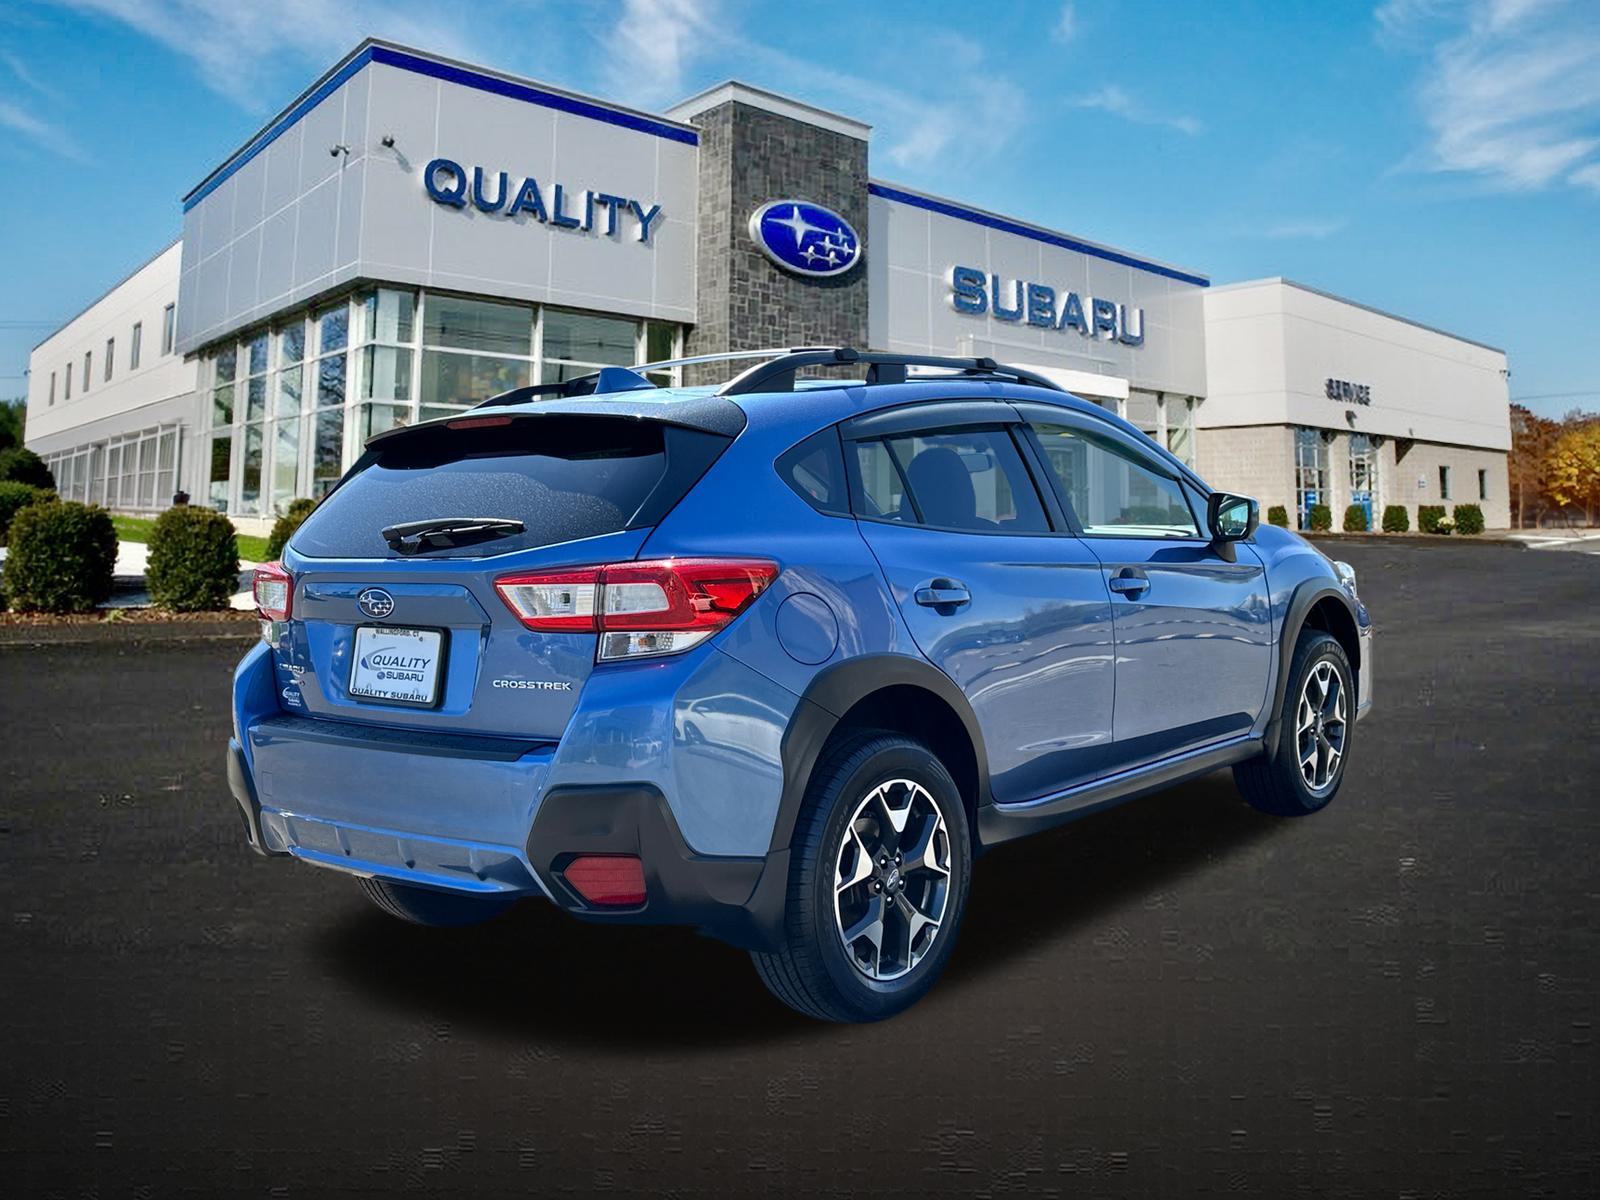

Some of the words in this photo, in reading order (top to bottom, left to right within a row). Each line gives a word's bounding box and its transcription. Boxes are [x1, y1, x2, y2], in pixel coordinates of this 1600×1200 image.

[423, 158, 661, 243] QUALITY
[951, 265, 1145, 347] SUBARU
[372, 655, 431, 669] QUALITY
[386, 671, 425, 682] SUBARU
[492, 679, 572, 691] CROSSTREK
[352, 687, 389, 698] QUALITY
[391, 691, 428, 702] SUBARU
